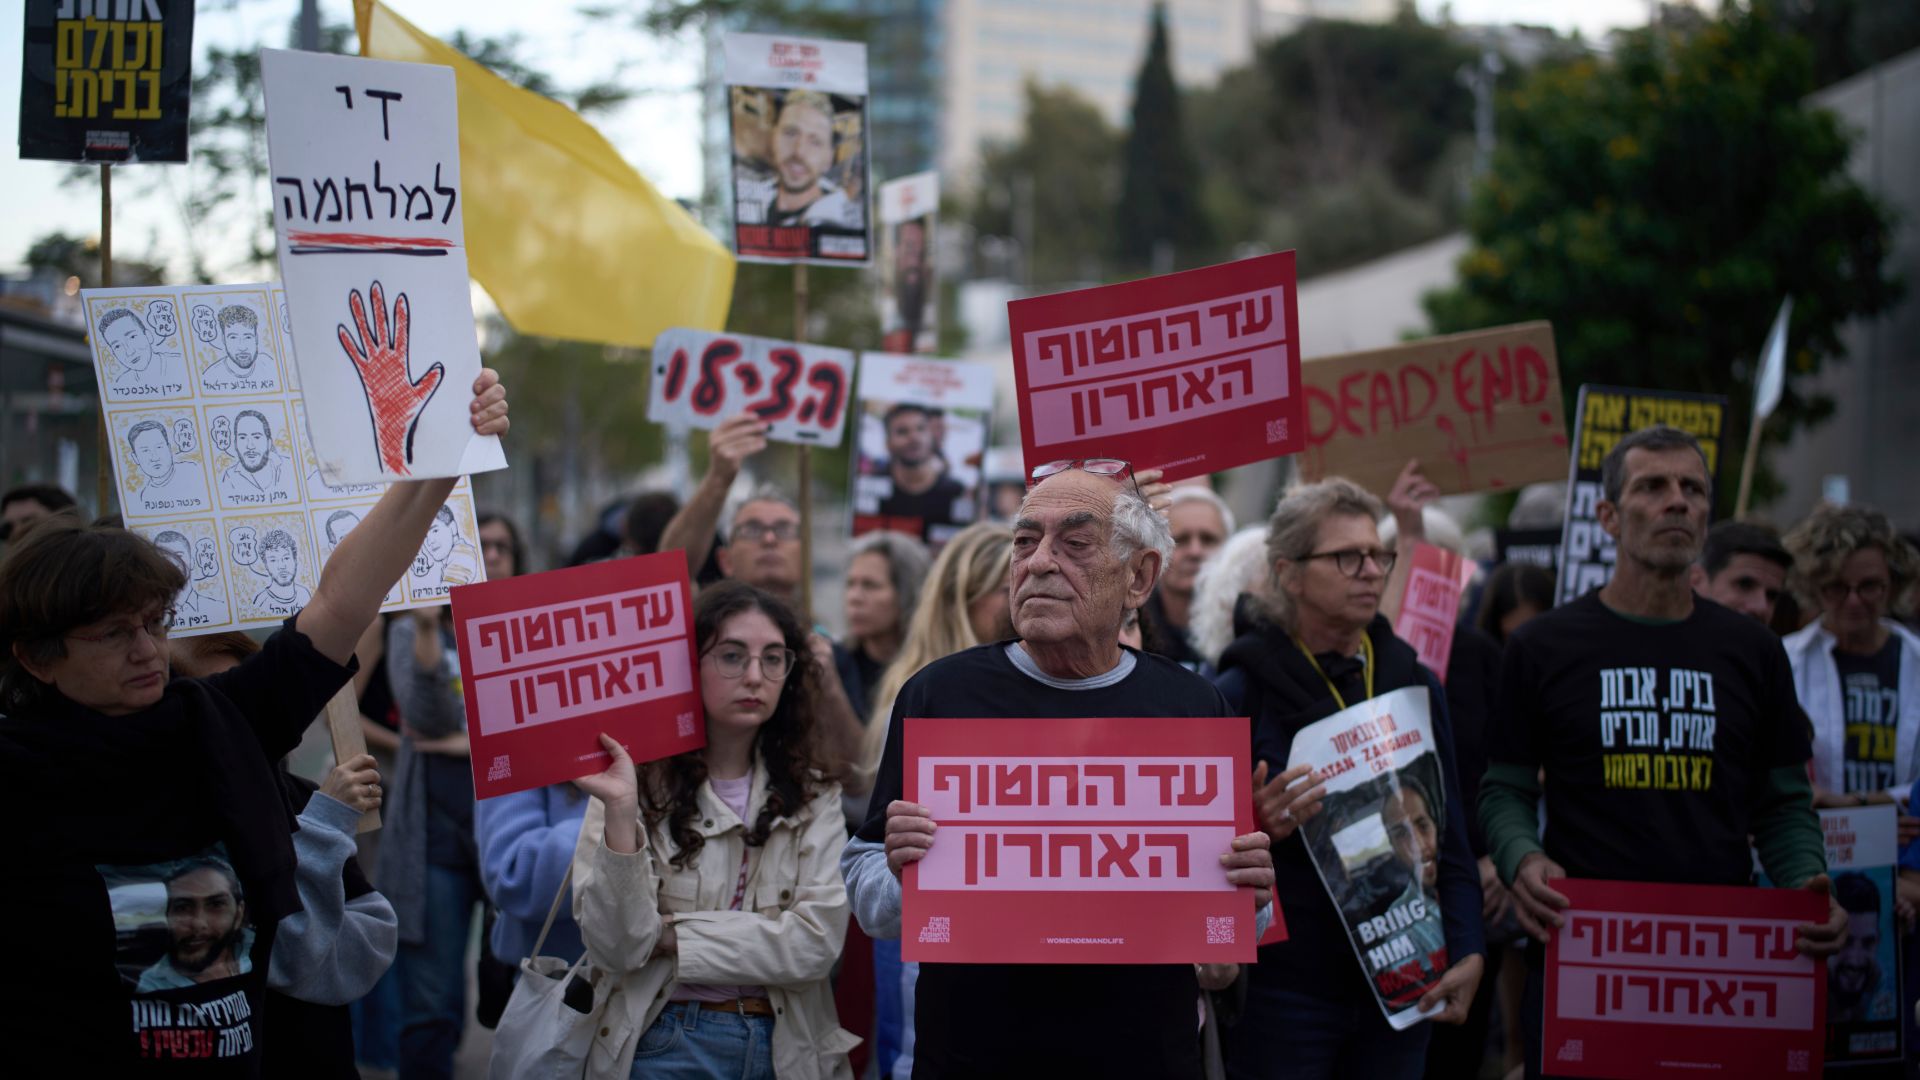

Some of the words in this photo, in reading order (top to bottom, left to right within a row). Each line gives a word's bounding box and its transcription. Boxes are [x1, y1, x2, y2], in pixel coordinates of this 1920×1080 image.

[57, 16, 163, 69] וכולם
[55, 69, 162, 119] בבית!
[336, 85, 402, 141] די
[276, 160, 457, 225] למלחמה
[1210, 295, 1274, 340] עד
[1038, 310, 1200, 376] החטוף
[112, 384, 159, 396] אלכסנדר
[161, 383, 183, 396] עידן
[203, 380, 229, 390] דלאל
[230, 379, 257, 390] גלבוע
[663, 339, 846, 430] הצילו
[1070, 358, 1254, 436] האחרון
[1302, 364, 1438, 450] DEAD
[1450, 345, 1549, 418] END
[1583, 392, 1626, 430] את
[1628, 396, 1722, 438] הפסיקו
[269, 491, 288, 503] מתן
[435, 586, 450, 596] סים
[621, 590, 674, 631] עד
[189, 615, 209, 627] ביפין
[478, 600, 617, 664] החטוף
[509, 650, 664, 724] האחרון
[1600, 667, 1657, 709] אבות
[1662, 668, 1716, 713] בנים,
[1600, 710, 1659, 748] חברים
[1664, 712, 1716, 752] אחים,
[933, 764, 1126, 814] החטוף
[1137, 764, 1219, 806] עד
[1317, 756, 1356, 780] ATAN
[1654, 754, 1688, 789] זבח
[1691, 755, 1713, 791] לא
[964, 833, 1190, 886] האחרון
[1046, 937, 1125, 945] WOMENDEMANDLIFE
[1357, 898, 1426, 946] BRING
[1571, 916, 1728, 958] החטוף
[1738, 925, 1801, 961] עד
[1367, 934, 1416, 970] HIM
[130, 999, 172, 1033] מתן
[1595, 973, 1777, 1018] האחרון
